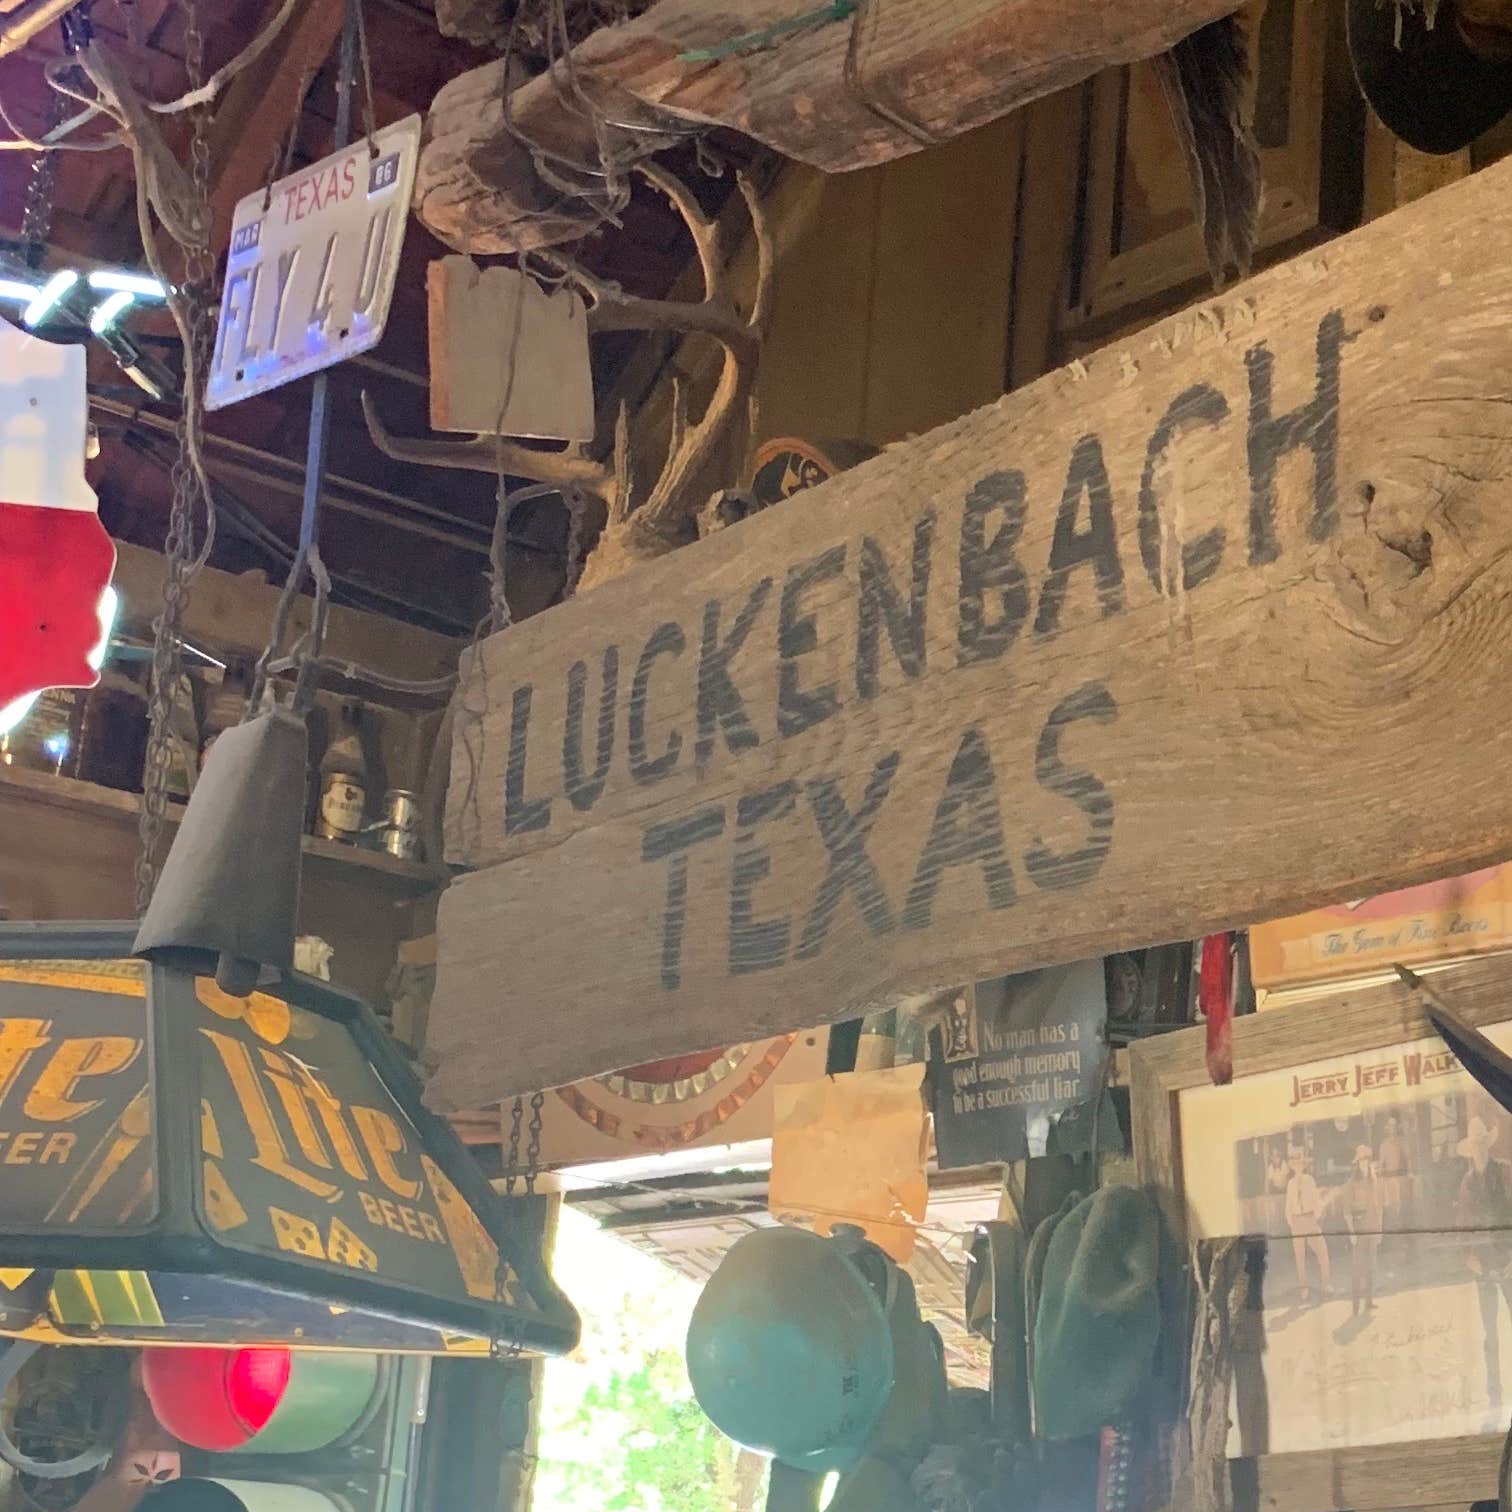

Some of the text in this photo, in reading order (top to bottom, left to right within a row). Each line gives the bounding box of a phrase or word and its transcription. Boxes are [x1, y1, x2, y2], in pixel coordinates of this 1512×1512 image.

[284, 158, 357, 225] TEXAS
[504, 309, 1350, 836] LUCKENBACH
[641, 680, 1118, 992] TEXAS
[1006, 1028, 1036, 1049] man
[1040, 1022, 1066, 1046] has
[1070, 1022, 1079, 1041] a
[953, 1050, 1081, 1092] good enough memory
[985, 1077, 1049, 1108] successful
[1290, 1073, 1350, 1107] JERRY
[1352, 1063, 1400, 1098] JEFF
[358, 1191, 447, 1244] BEER
